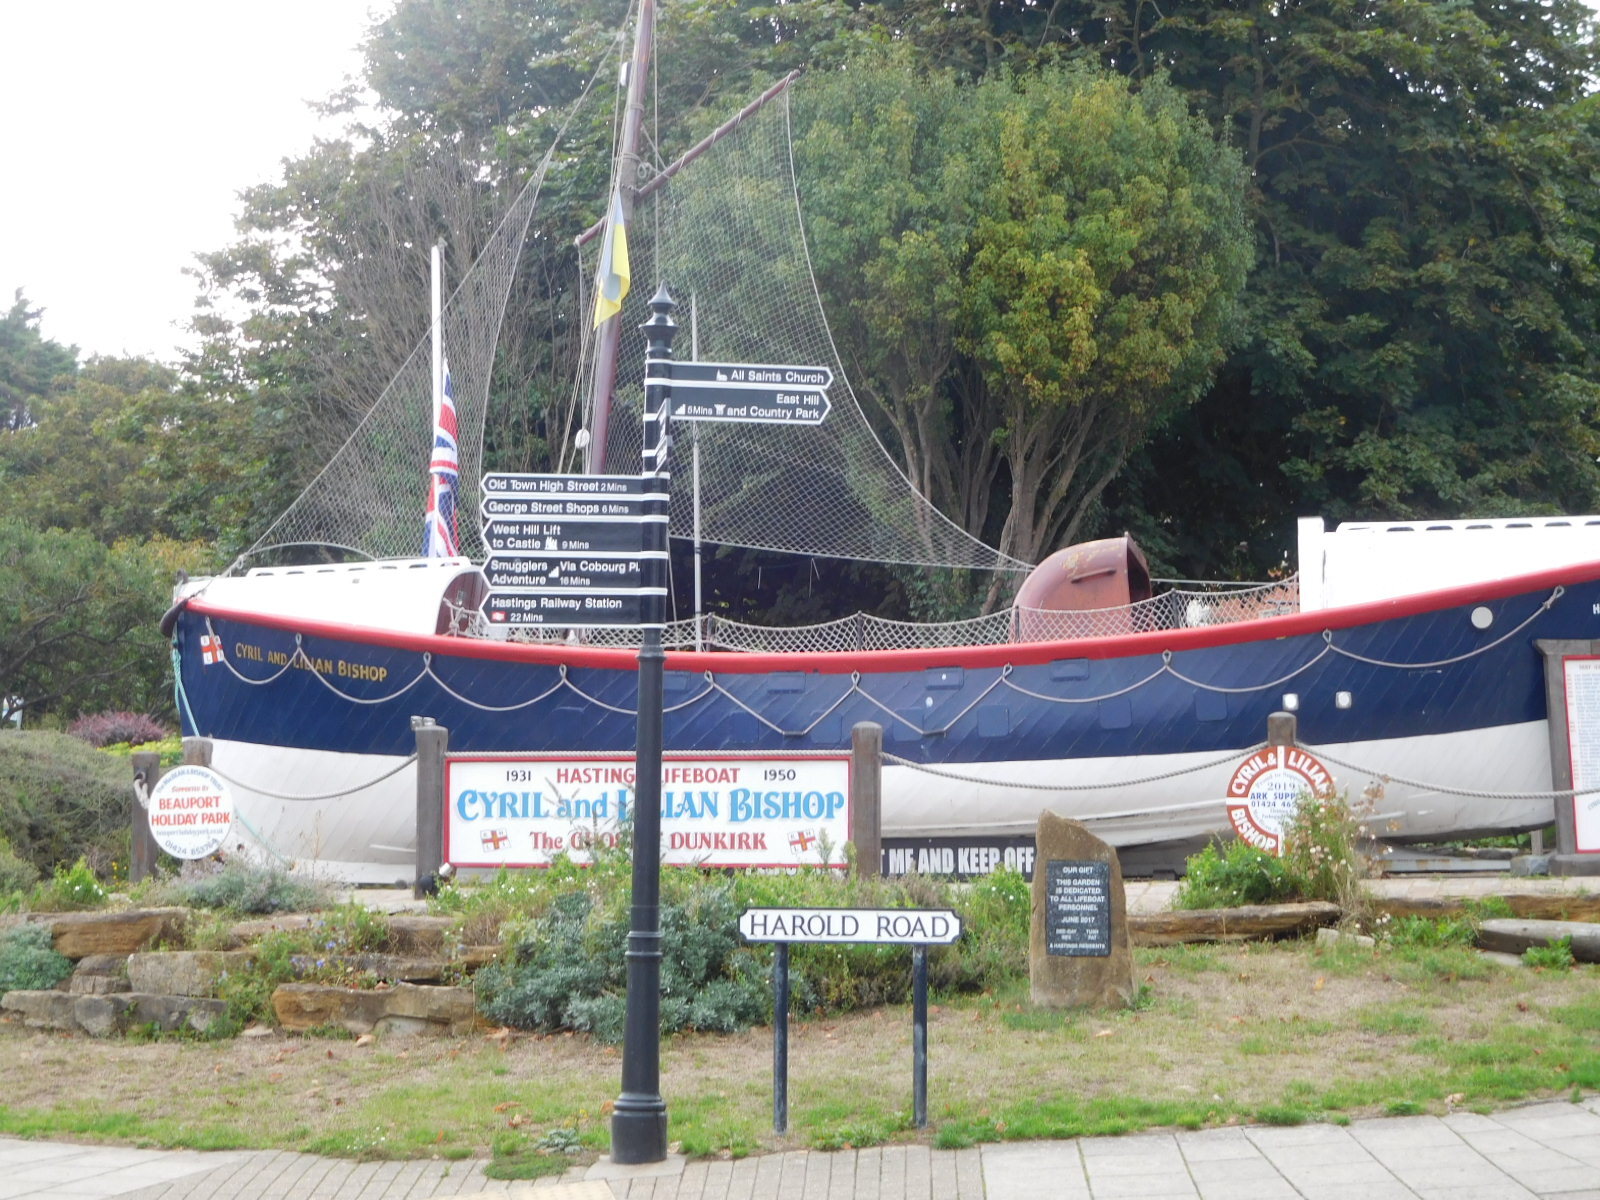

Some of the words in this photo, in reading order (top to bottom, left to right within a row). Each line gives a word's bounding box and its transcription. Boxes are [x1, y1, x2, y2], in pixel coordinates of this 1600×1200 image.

[731, 371, 745, 381] All
[748, 371, 782, 382] Saints
[785, 371, 824, 384] Church
[776, 394, 800, 405] East
[803, 395, 820, 406] Hill
[727, 406, 747, 417] and
[750, 406, 793, 420] Country
[795, 408, 819, 419] Park
[488, 479, 507, 490] Old
[511, 480, 537, 491] Town
[539, 480, 563, 493] High
[567, 480, 599, 491] Street
[488, 501, 528, 514] George
[531, 502, 563, 513] Street
[566, 502, 600, 515] Shops
[492, 524, 520, 535] West
[523, 524, 540, 535] Hill
[543, 524, 561, 536] Lift
[493, 538, 503, 548] to
[507, 537, 541, 549] Castle
[569, 540, 590, 549] Mins
[491, 560, 548, 574] Smugglers
[560, 560, 577, 571] Via
[579, 561, 626, 575] Cobourg
[491, 574, 547, 586] Adventure
[491, 597, 537, 610] Hastings
[540, 597, 582, 611] Railway
[585, 598, 623, 609] Station
[235, 642, 263, 662] CYRIL
[267, 651, 288, 666] AND
[338, 660, 387, 682] BISHOP
[1267, 752, 1277, 766] &
[506, 770, 532, 782] 1931
[556, 768, 636, 784] HASTING
[662, 767, 740, 784] IFEBOAT
[764, 769, 796, 781] 1950
[1231, 755, 1267, 795] CYRIL
[1267, 782, 1296, 791] 2019
[159, 796, 221, 810] BEAUPORT
[1250, 792, 1268, 800] ARK
[457, 789, 549, 821] CYRIL
[556, 792, 608, 819] and
[729, 788, 845, 823] BISHOP
[151, 813, 198, 826] HOLIDAY
[201, 812, 231, 824] PARK
[1231, 808, 1277, 851] BISHOP
[529, 831, 563, 850] The
[670, 832, 768, 850] DUNKIRK
[889, 848, 915, 874] ME
[917, 848, 954, 874] AND
[958, 847, 1000, 873] KEEP
[1004, 847, 1034, 873] OFF
[1074, 895, 1105, 903] LIFEBOAT
[749, 914, 859, 937] HAROLD
[876, 915, 950, 938] ROAD
